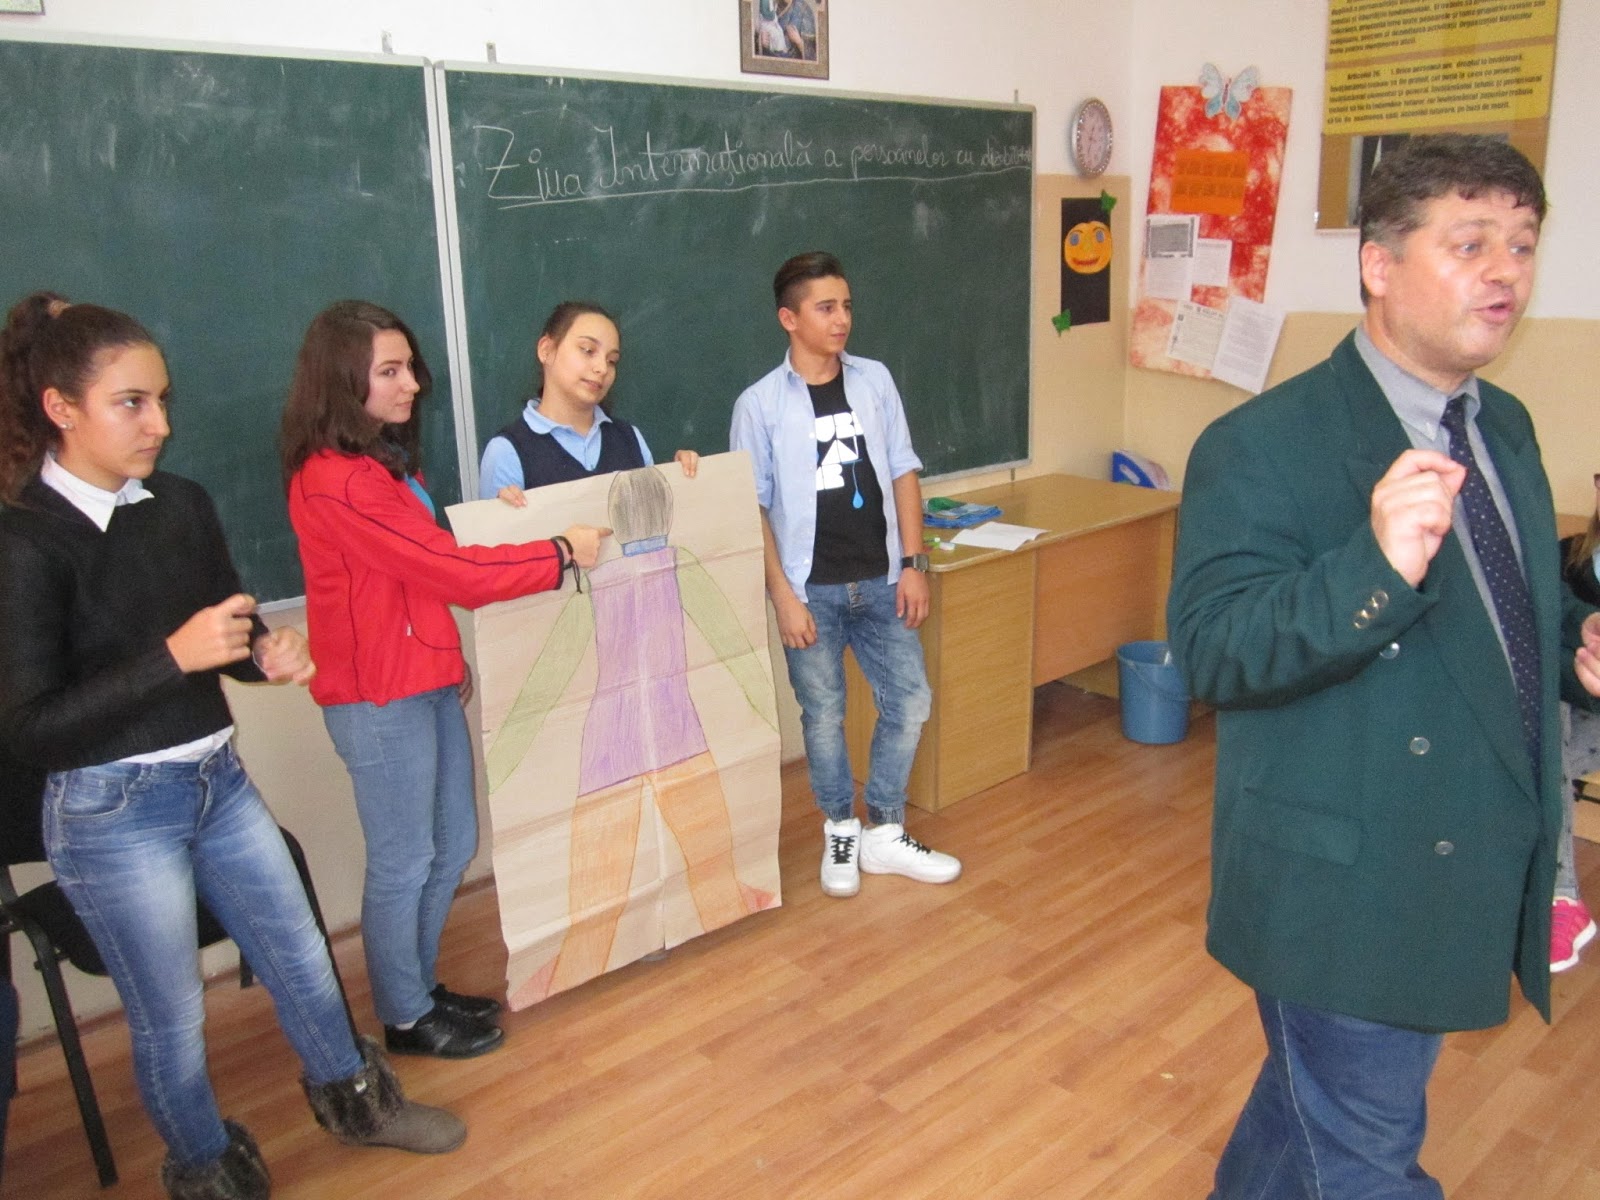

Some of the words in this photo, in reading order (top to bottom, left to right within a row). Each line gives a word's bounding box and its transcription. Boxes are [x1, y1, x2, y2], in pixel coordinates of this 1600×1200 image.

[473, 125, 586, 200] Ziua
[825, 149, 843, 167] a
[957, 149, 974, 165] cu
